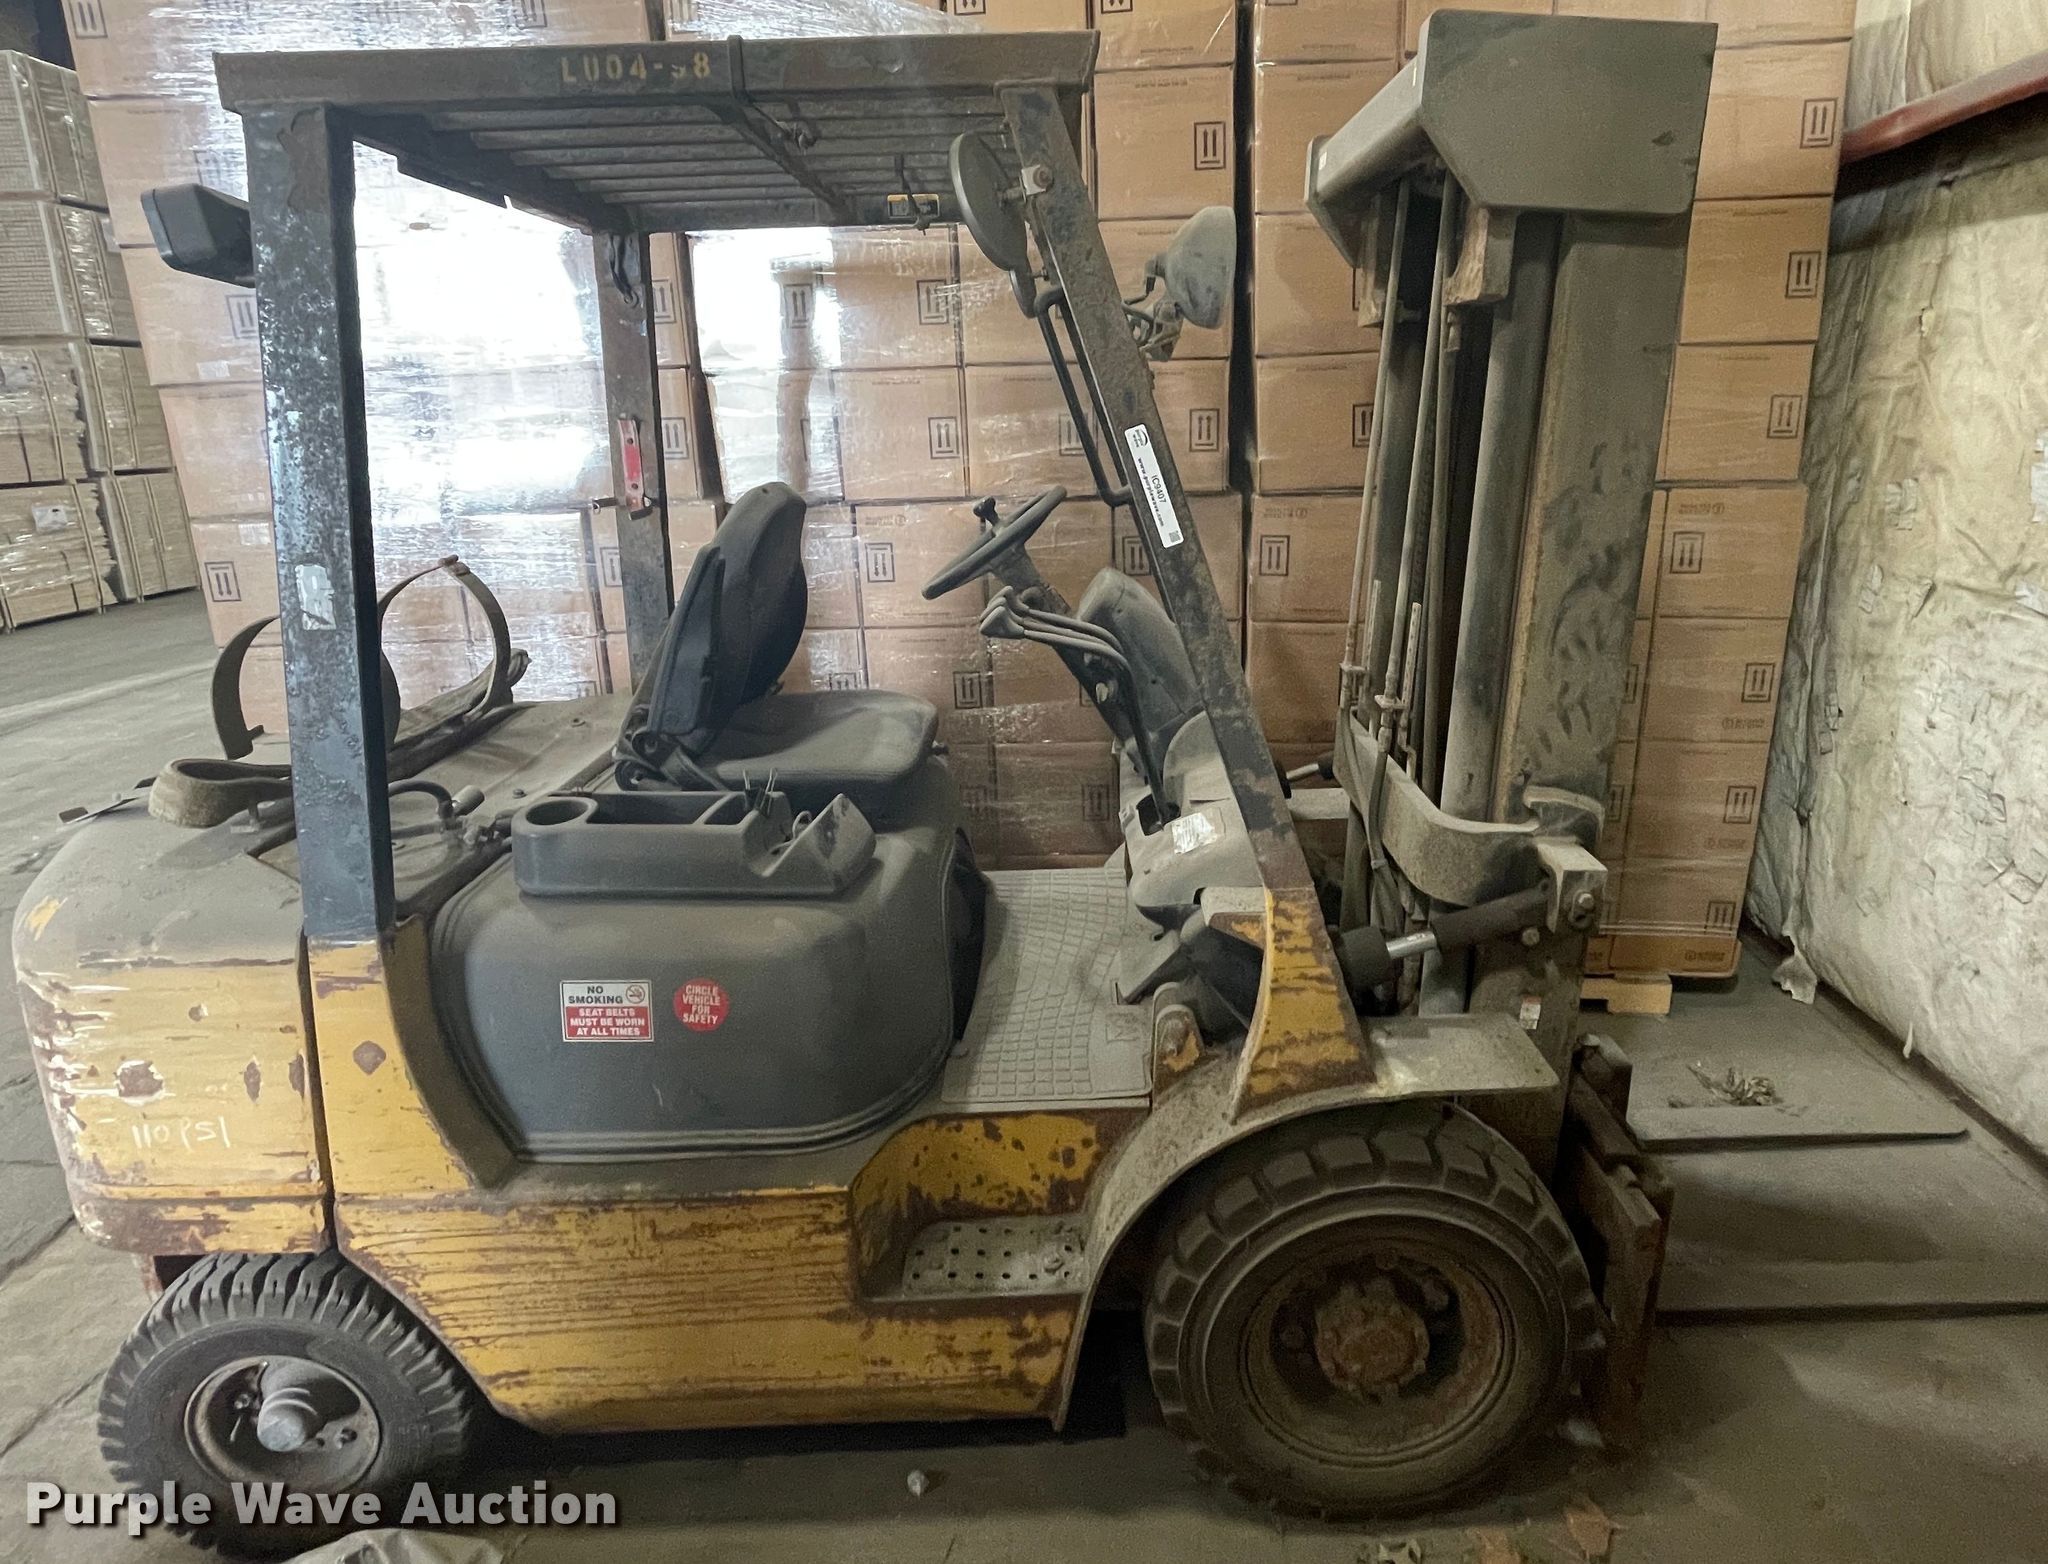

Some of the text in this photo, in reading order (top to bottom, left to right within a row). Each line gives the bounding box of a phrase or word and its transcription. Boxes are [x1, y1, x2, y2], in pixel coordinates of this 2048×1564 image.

[1138, 457, 1164, 527] www.purplewave.com
[1151, 475, 1167, 503] IC9407
[587, 985, 604, 994] NO
[685, 984, 719, 996] CIRCLE
[568, 995, 624, 1004] SMOKING
[682, 994, 720, 1006] VEHICLE
[578, 1008, 635, 1017] SEAT BELTS
[691, 1004, 710, 1015] FOR
[569, 1018, 645, 1026] MUST BE WORN
[682, 1012, 719, 1025] SAFETY
[576, 1027, 640, 1036] AT ALL TIMES
